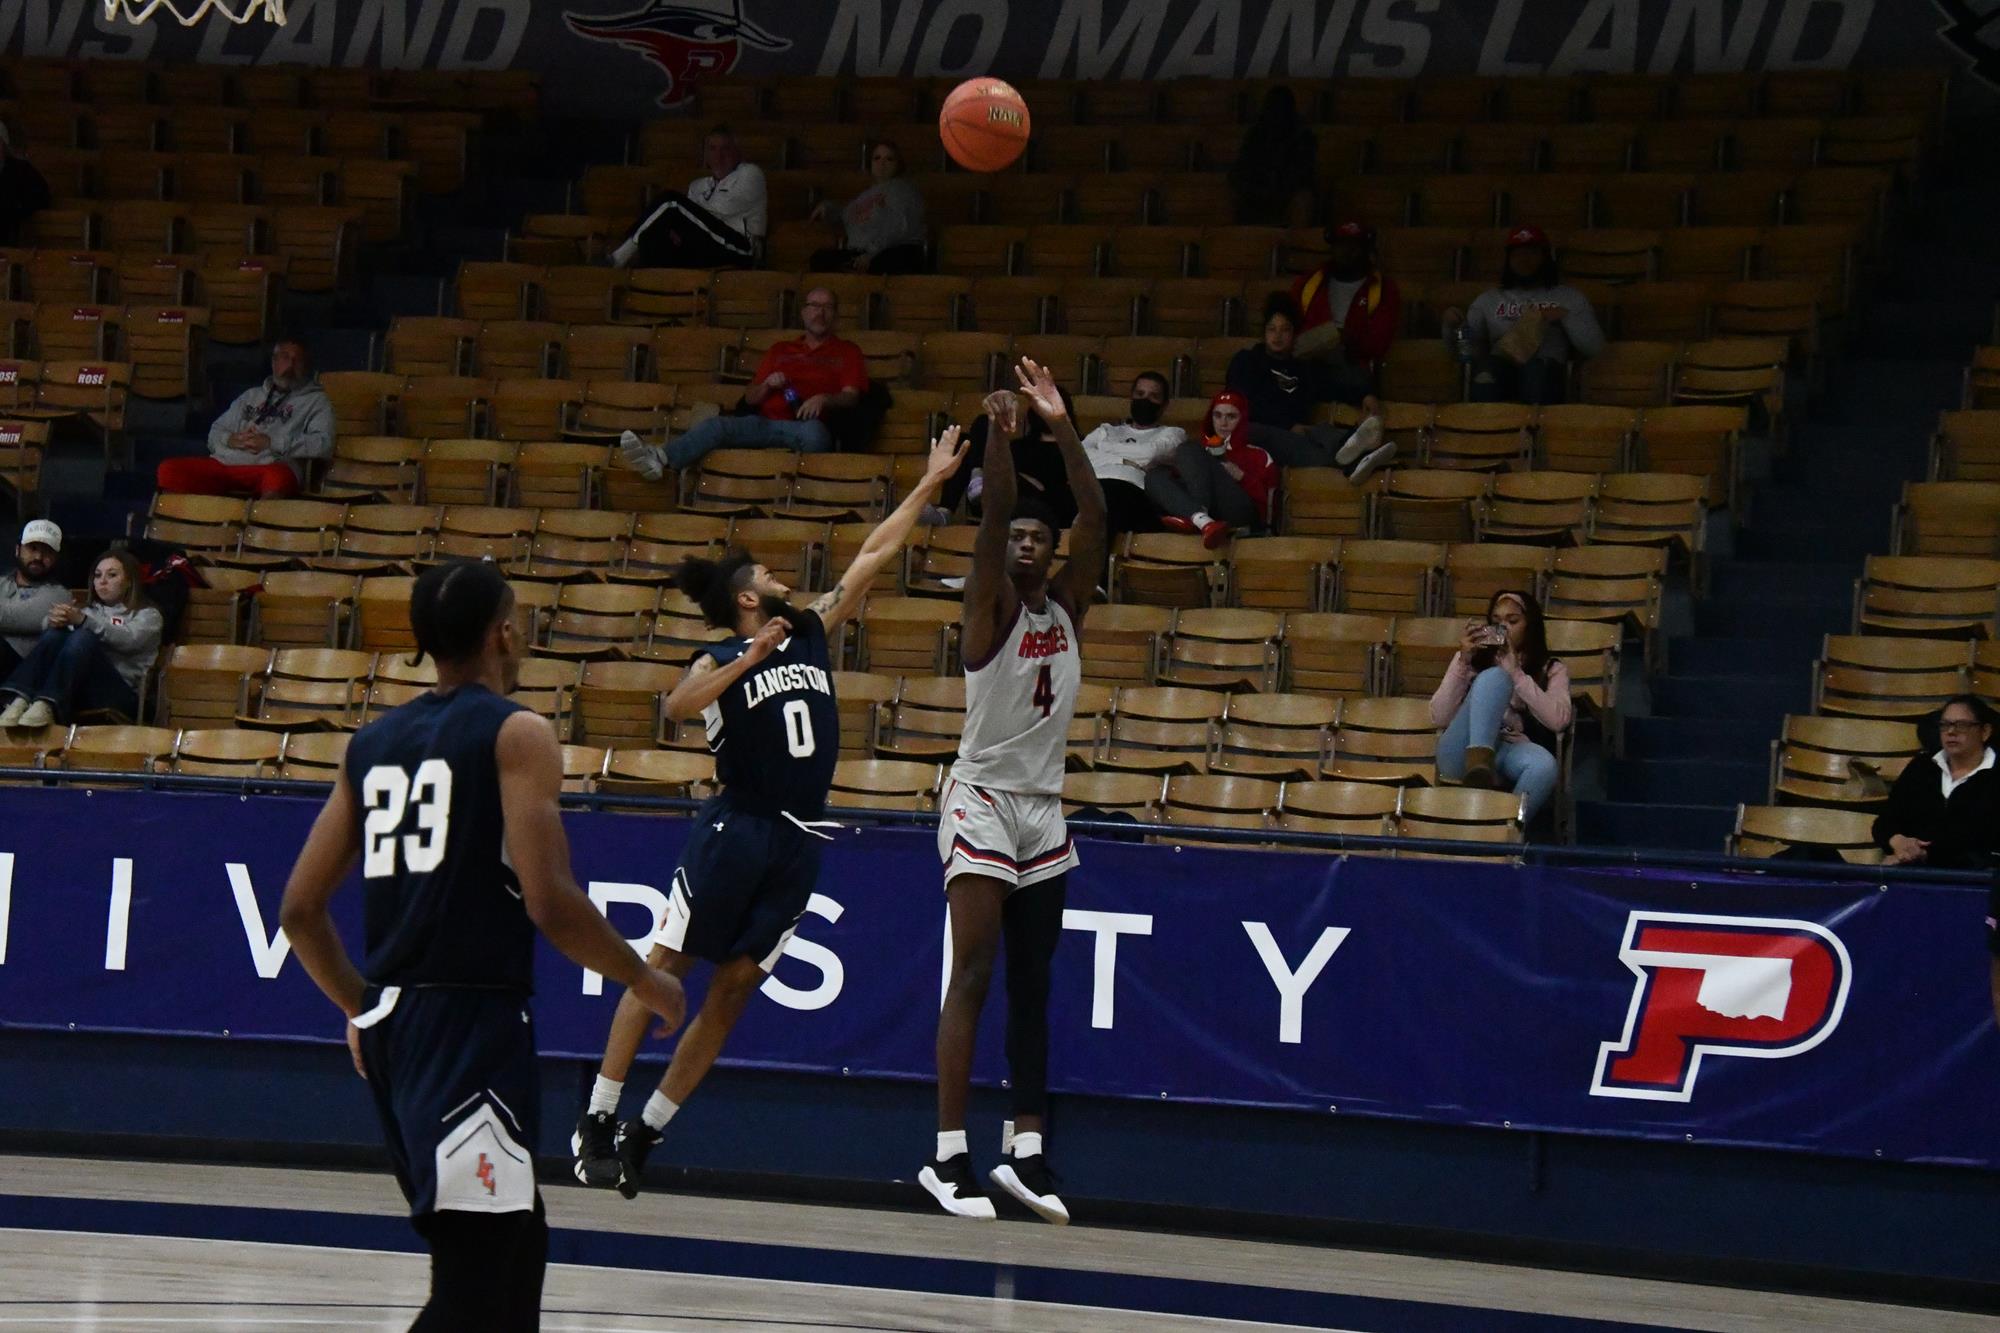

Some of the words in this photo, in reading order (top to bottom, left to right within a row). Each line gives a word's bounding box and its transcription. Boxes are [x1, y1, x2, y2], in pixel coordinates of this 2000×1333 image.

[196, 0, 531, 71] LAND
[816, 0, 1010, 78] NO
[1039, 0, 1434, 80] MANS
[1477, 0, 1874, 75] LAND
[78, 373, 105, 385] ROSE
[1018, 624, 1068, 658] AGGIES
[743, 663, 831, 709] LANGSTON
[1033, 664, 1055, 718] 4
[782, 699, 816, 759] 0
[363, 758, 453, 879] 23
[1589, 910, 1853, 1103] P
